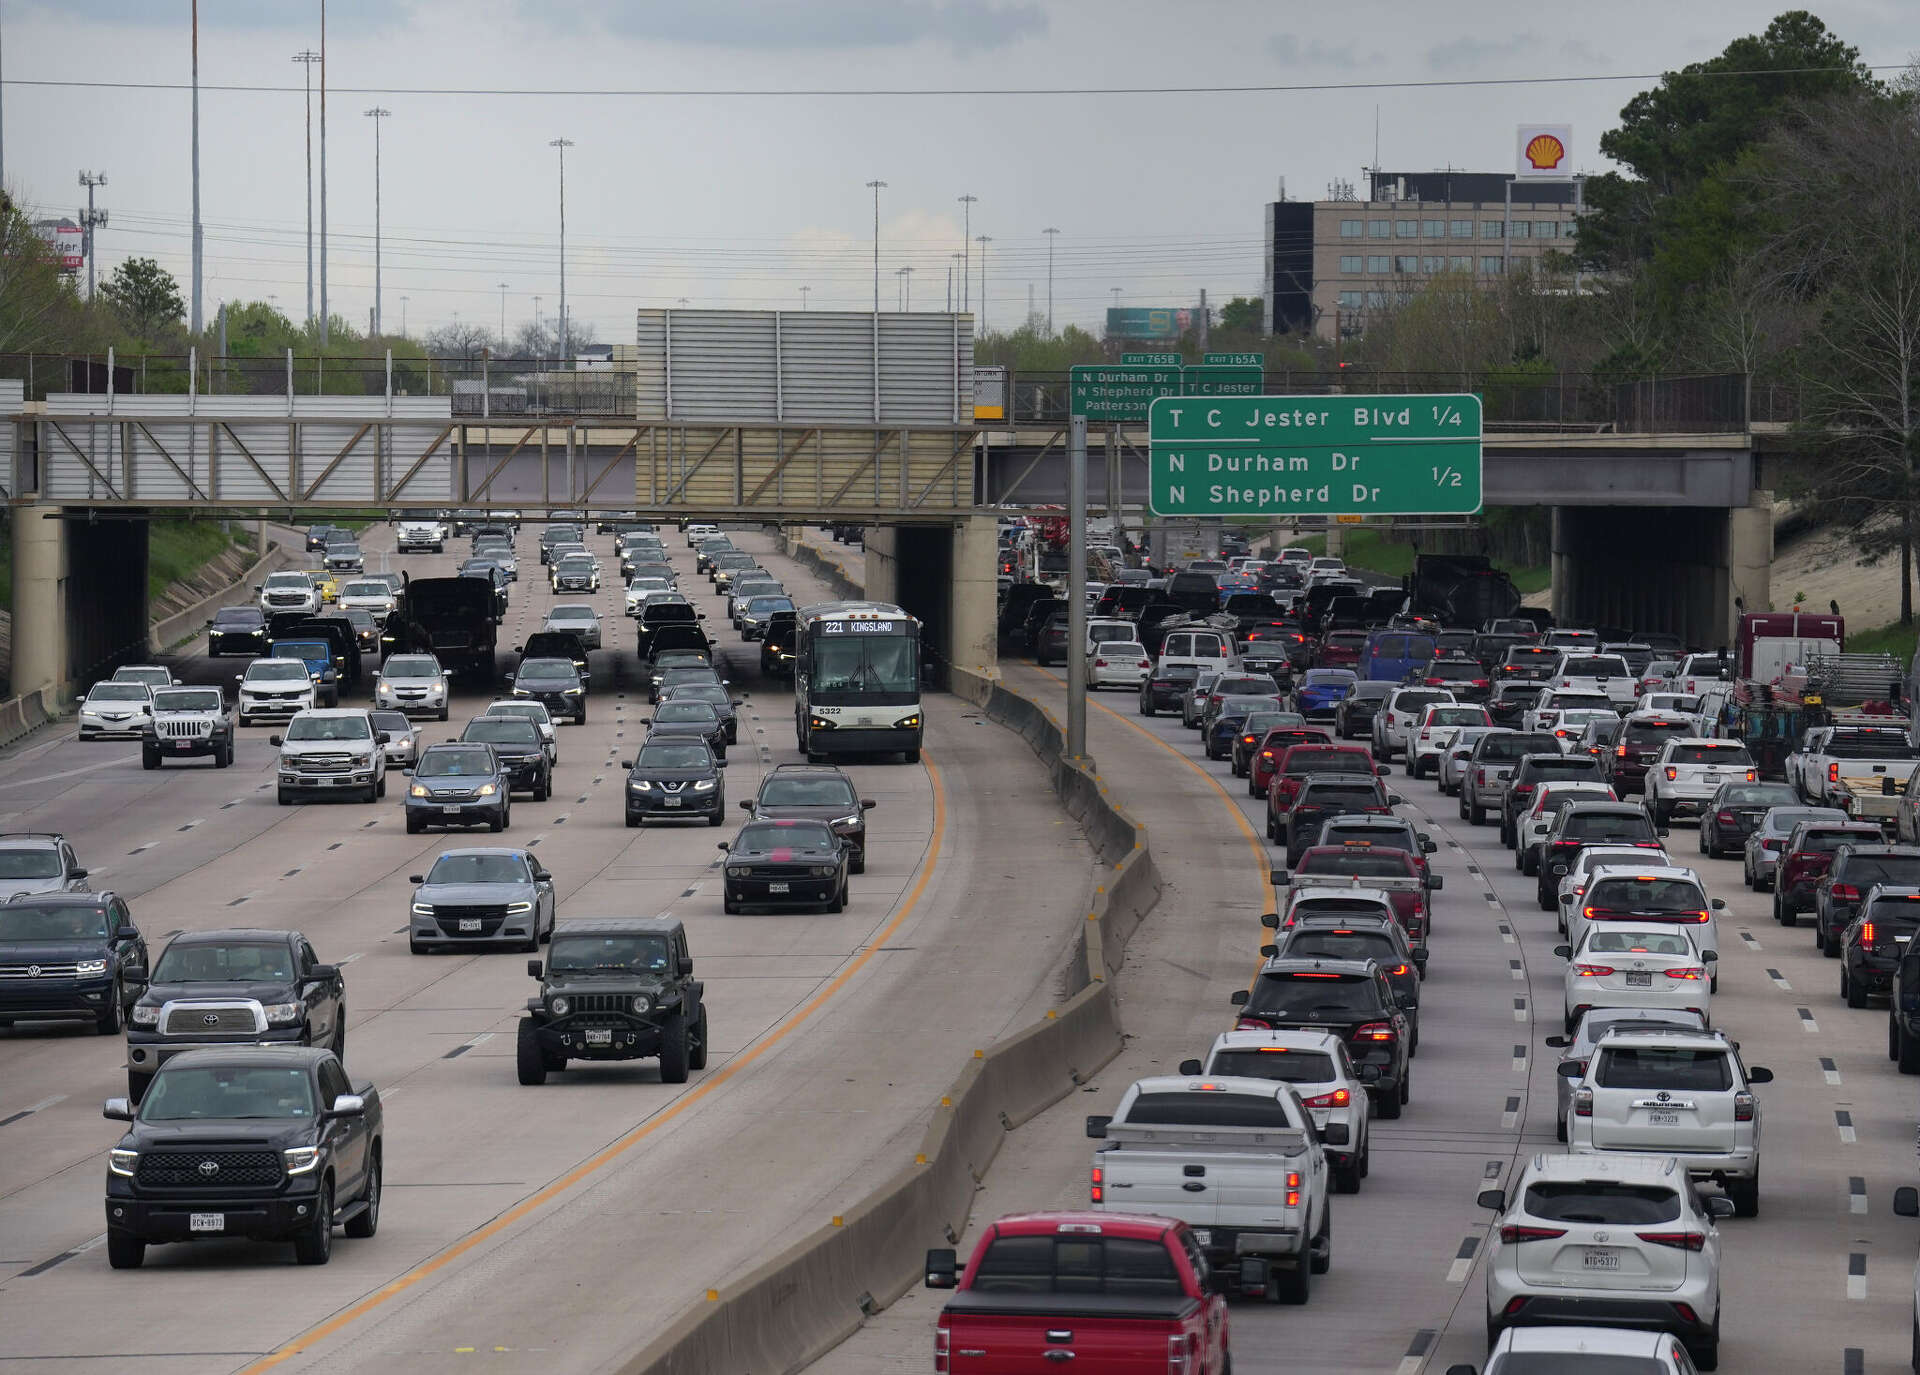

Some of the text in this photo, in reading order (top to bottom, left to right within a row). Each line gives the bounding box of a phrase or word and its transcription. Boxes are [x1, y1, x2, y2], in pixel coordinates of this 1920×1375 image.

[1146, 354, 1175, 364] 765B
[1229, 354, 1257, 364] 765A
[1082, 372, 1168, 383] N Durham Dr
[1077, 386, 1174, 398] N Shepherd Dr
[1189, 383, 1257, 393] T C Jester
[1085, 400, 1147, 411] Patterson
[1169, 405, 1462, 428] T C Jester Blvd 1/4
[1169, 453, 1360, 472] N Durham Dr
[1431, 466, 1462, 487] 1/2
[1169, 484, 1380, 507] N Shepherd Dr
[825, 621, 893, 633] 221 KINGSLAND
[819, 707, 841, 715] 5322
